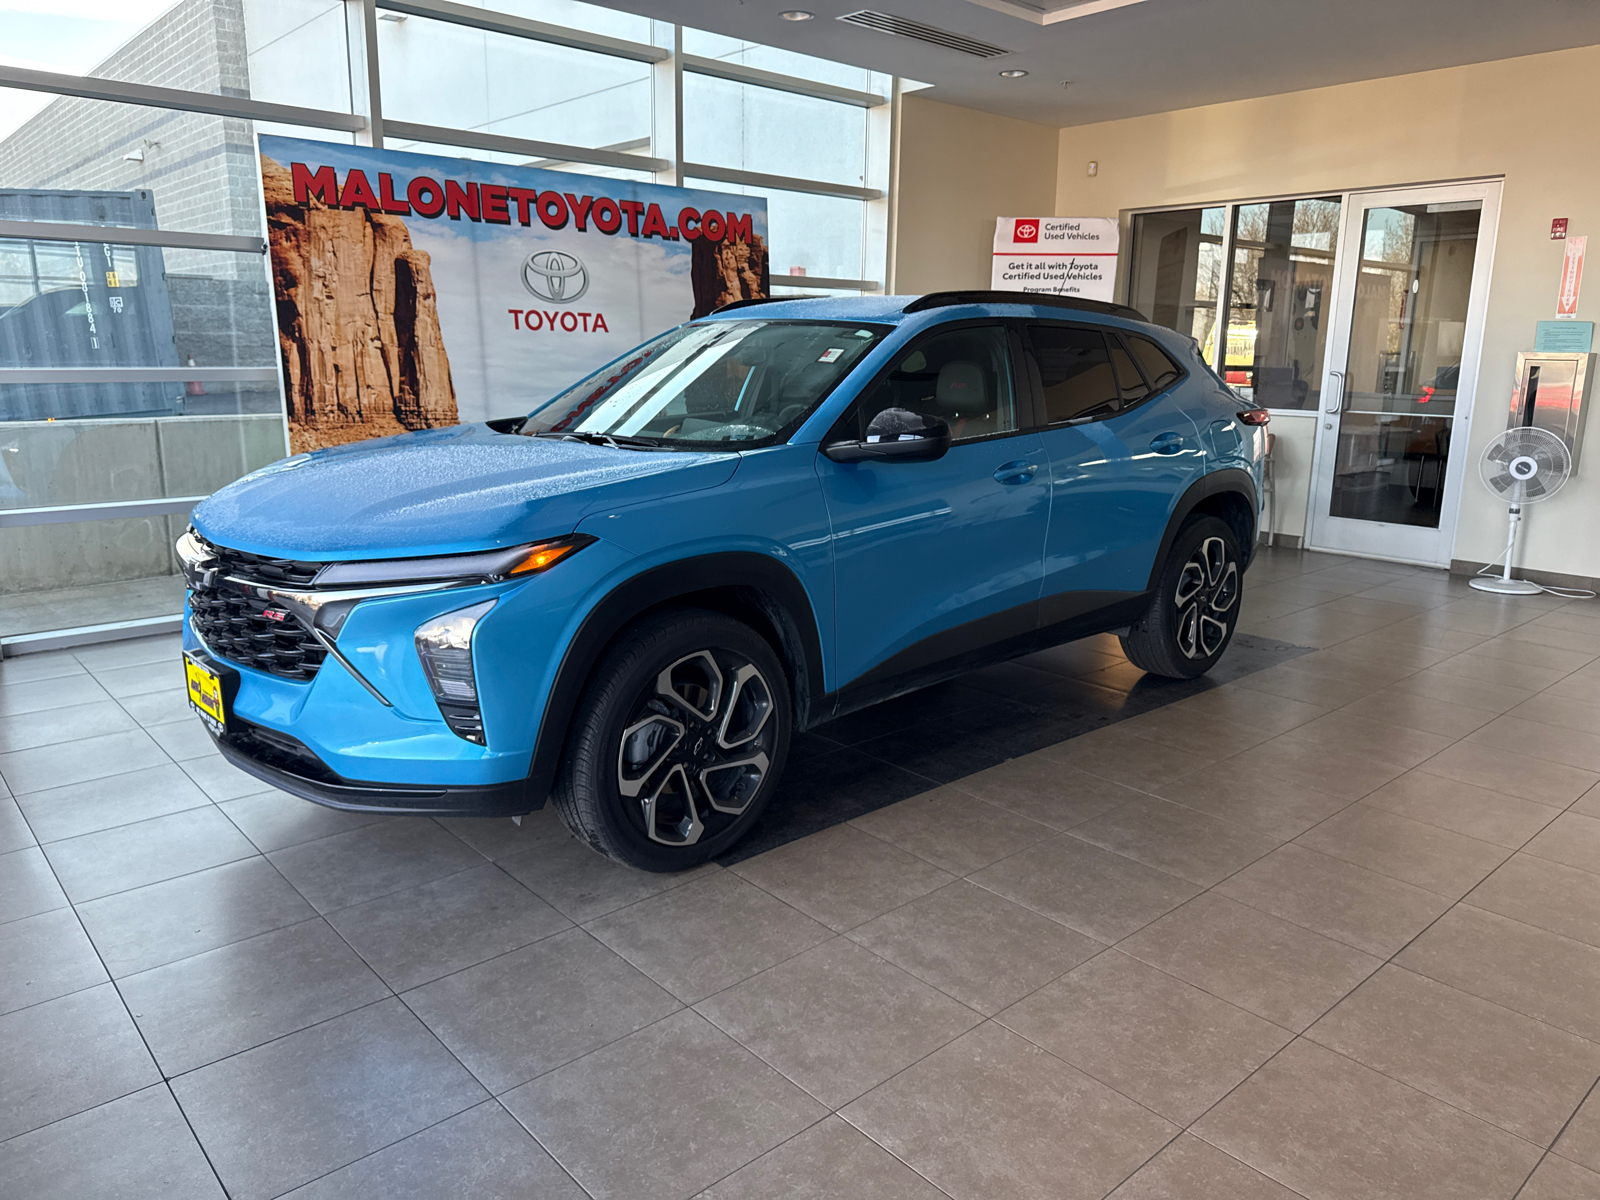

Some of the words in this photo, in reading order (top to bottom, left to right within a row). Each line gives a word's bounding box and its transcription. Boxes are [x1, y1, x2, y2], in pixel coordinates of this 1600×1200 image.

[291, 162, 753, 245] MALONETOYOTA.COM
[1044, 223, 1080, 231] Certified
[1044, 232, 1065, 240] Used
[1066, 232, 1100, 241] Vehicles
[1008, 262, 1025, 270] Get
[1026, 262, 1033, 270] it
[1034, 262, 1046, 270] all
[1047, 262, 1067, 270] with
[1068, 262, 1098, 272] Toyota
[1002, 272, 1041, 280] Certified
[1042, 272, 1065, 280] Used
[1066, 272, 1103, 281] Vehicles
[1023, 286, 1052, 294] Program
[508, 308, 609, 333] TOYOTA
